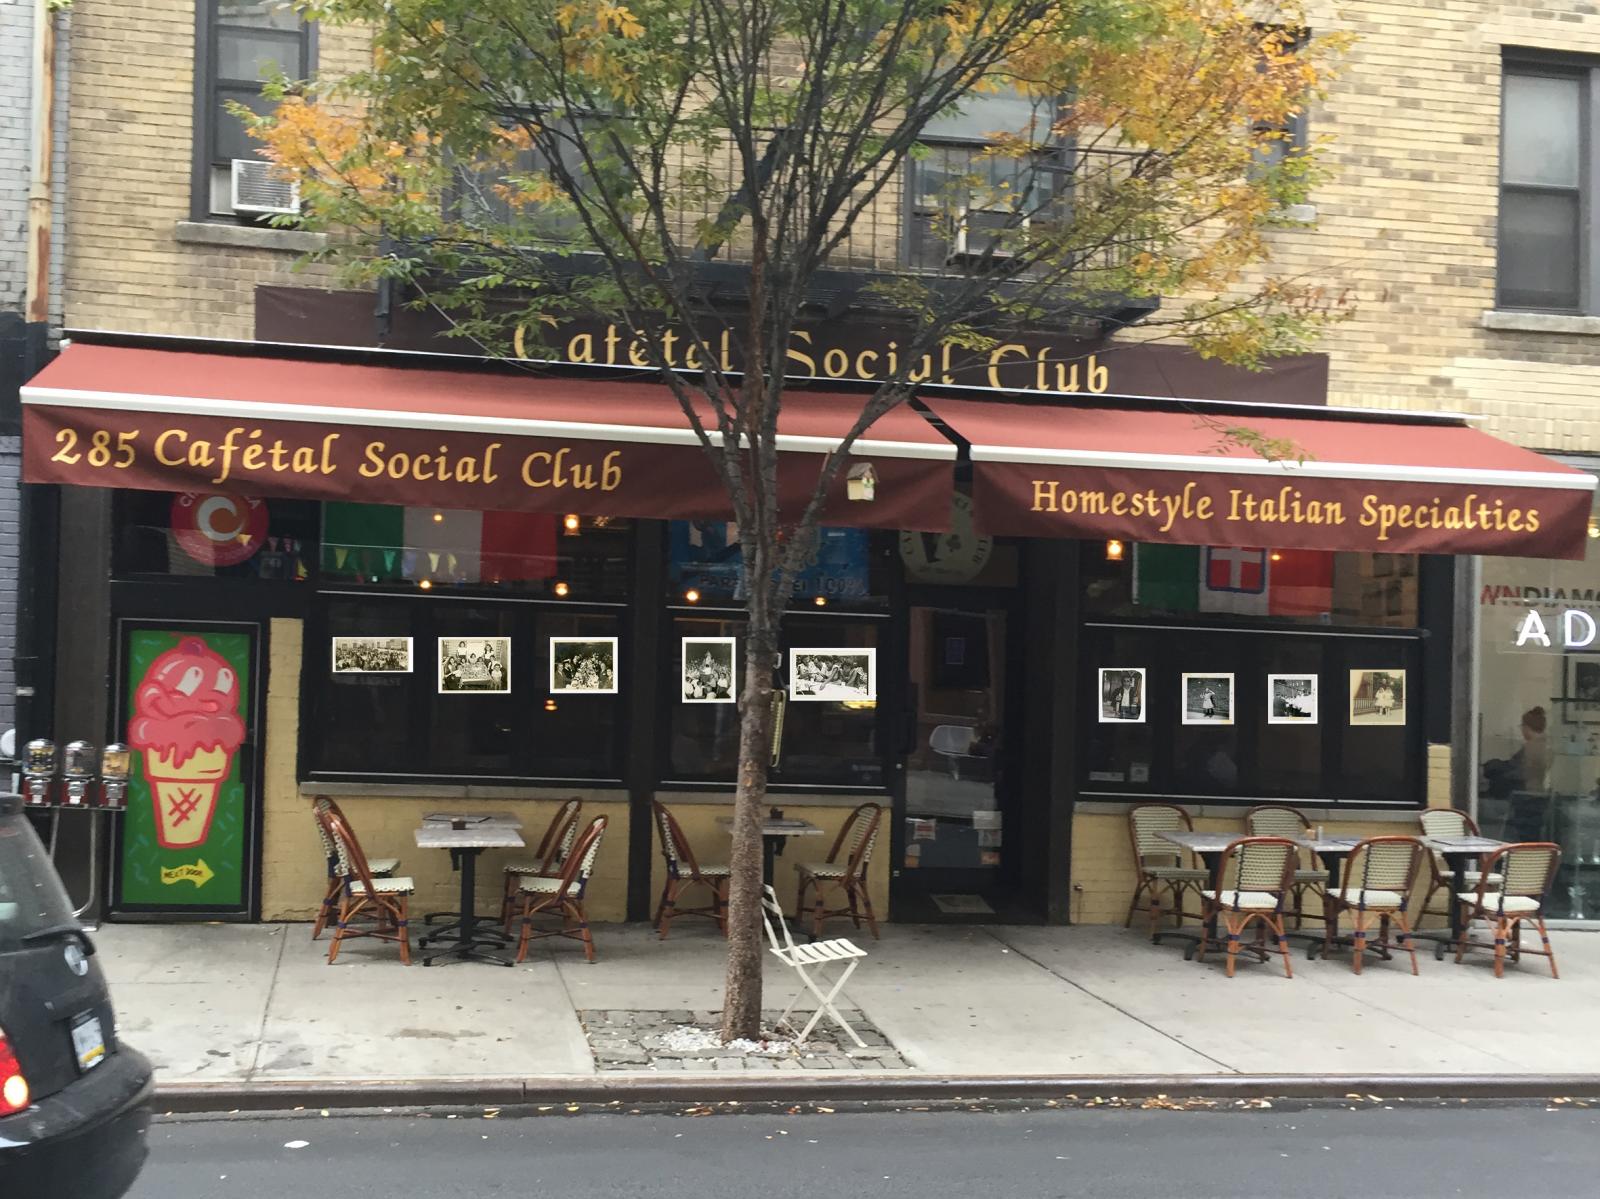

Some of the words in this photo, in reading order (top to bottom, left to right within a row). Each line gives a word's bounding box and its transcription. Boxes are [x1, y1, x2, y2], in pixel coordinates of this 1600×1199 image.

[986, 343, 1109, 394] Club
[51, 428, 140, 467] 285
[153, 428, 340, 484] Cafétal
[357, 442, 501, 487] Social
[521, 451, 621, 491] Club
[1032, 480, 1214, 533] Homestyle
[1226, 485, 1345, 526] Italian
[1358, 494, 1541, 541] Specialties
